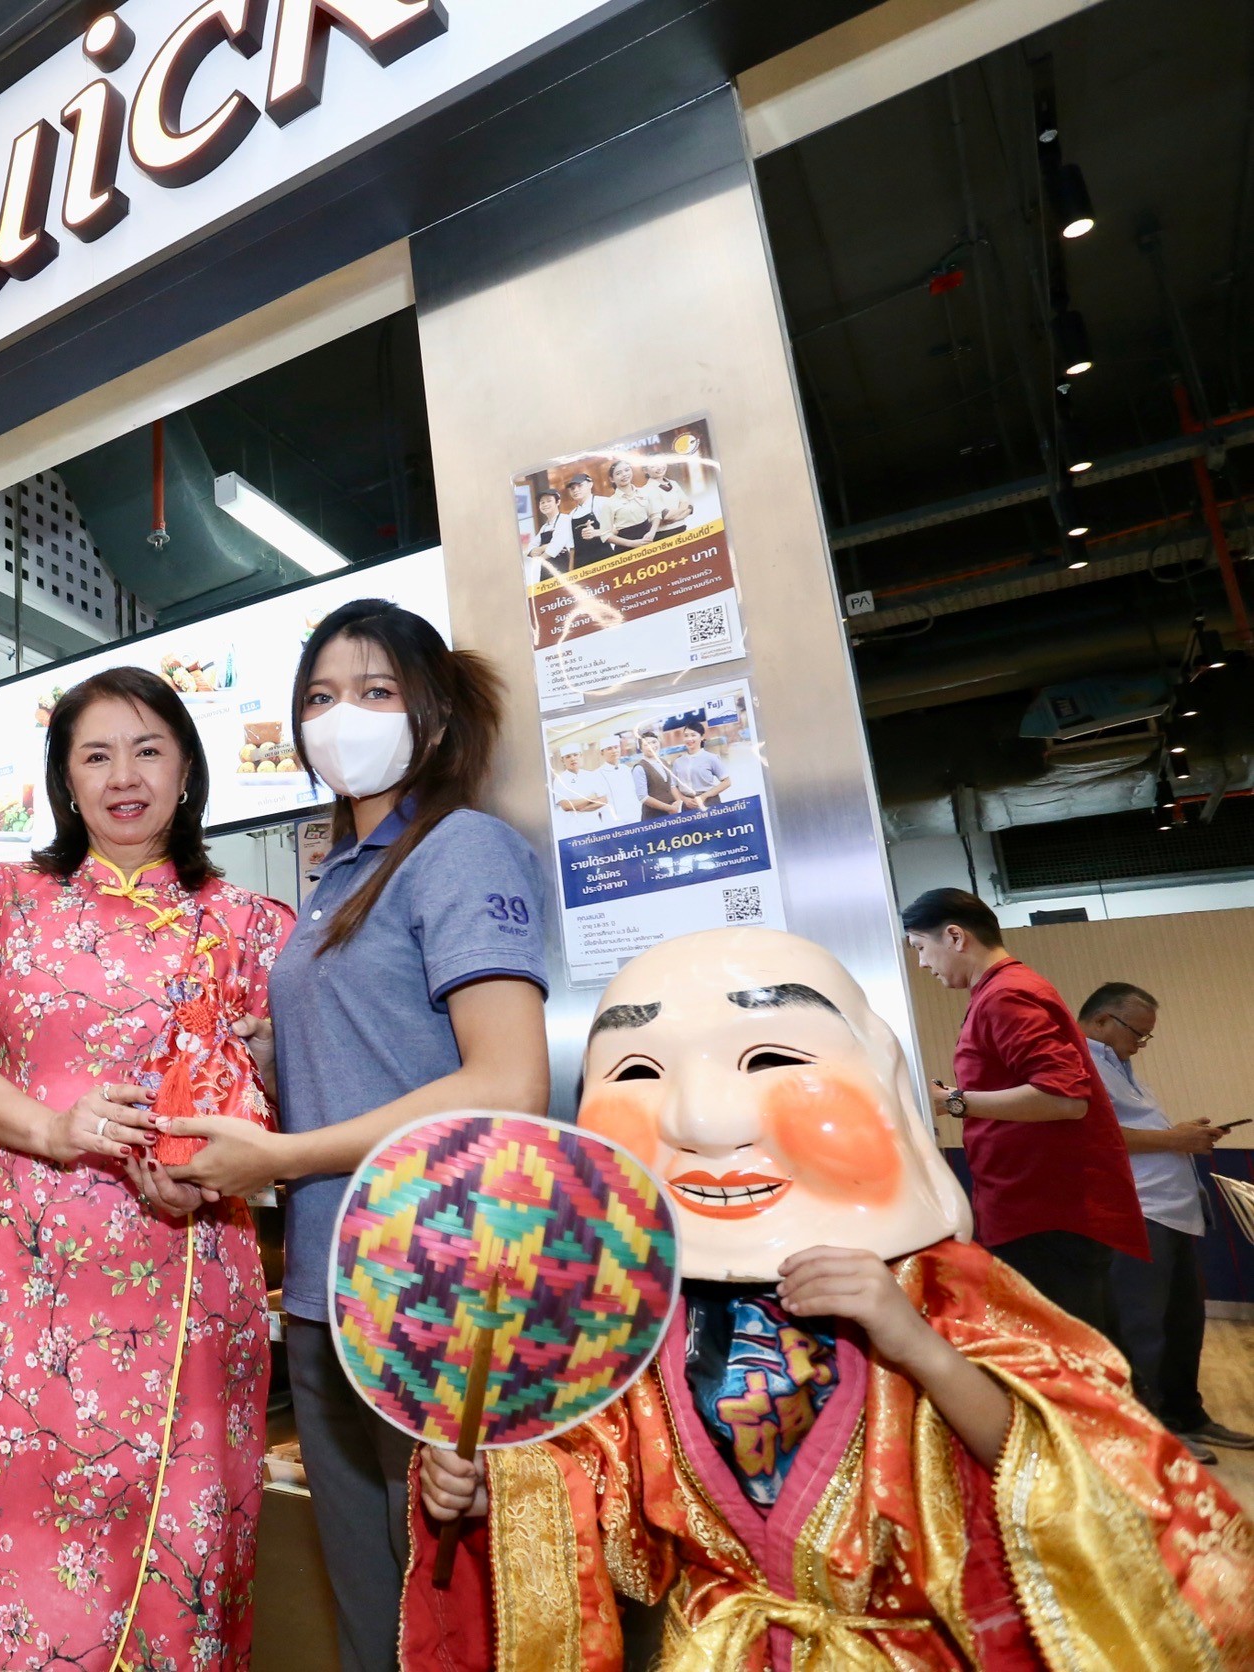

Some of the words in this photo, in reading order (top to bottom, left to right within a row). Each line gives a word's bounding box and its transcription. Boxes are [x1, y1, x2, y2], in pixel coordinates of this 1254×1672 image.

[612, 556, 689, 589] 14,600++
[691, 546, 718, 563] บาท
[571, 845, 644, 871] รายได้รวมขั้นต่ำ
[647, 829, 724, 855] 14,600++
[727, 823, 755, 838] บาท
[708, 845, 749, 860] นักงานครัว
[486, 893, 529, 926] 39
